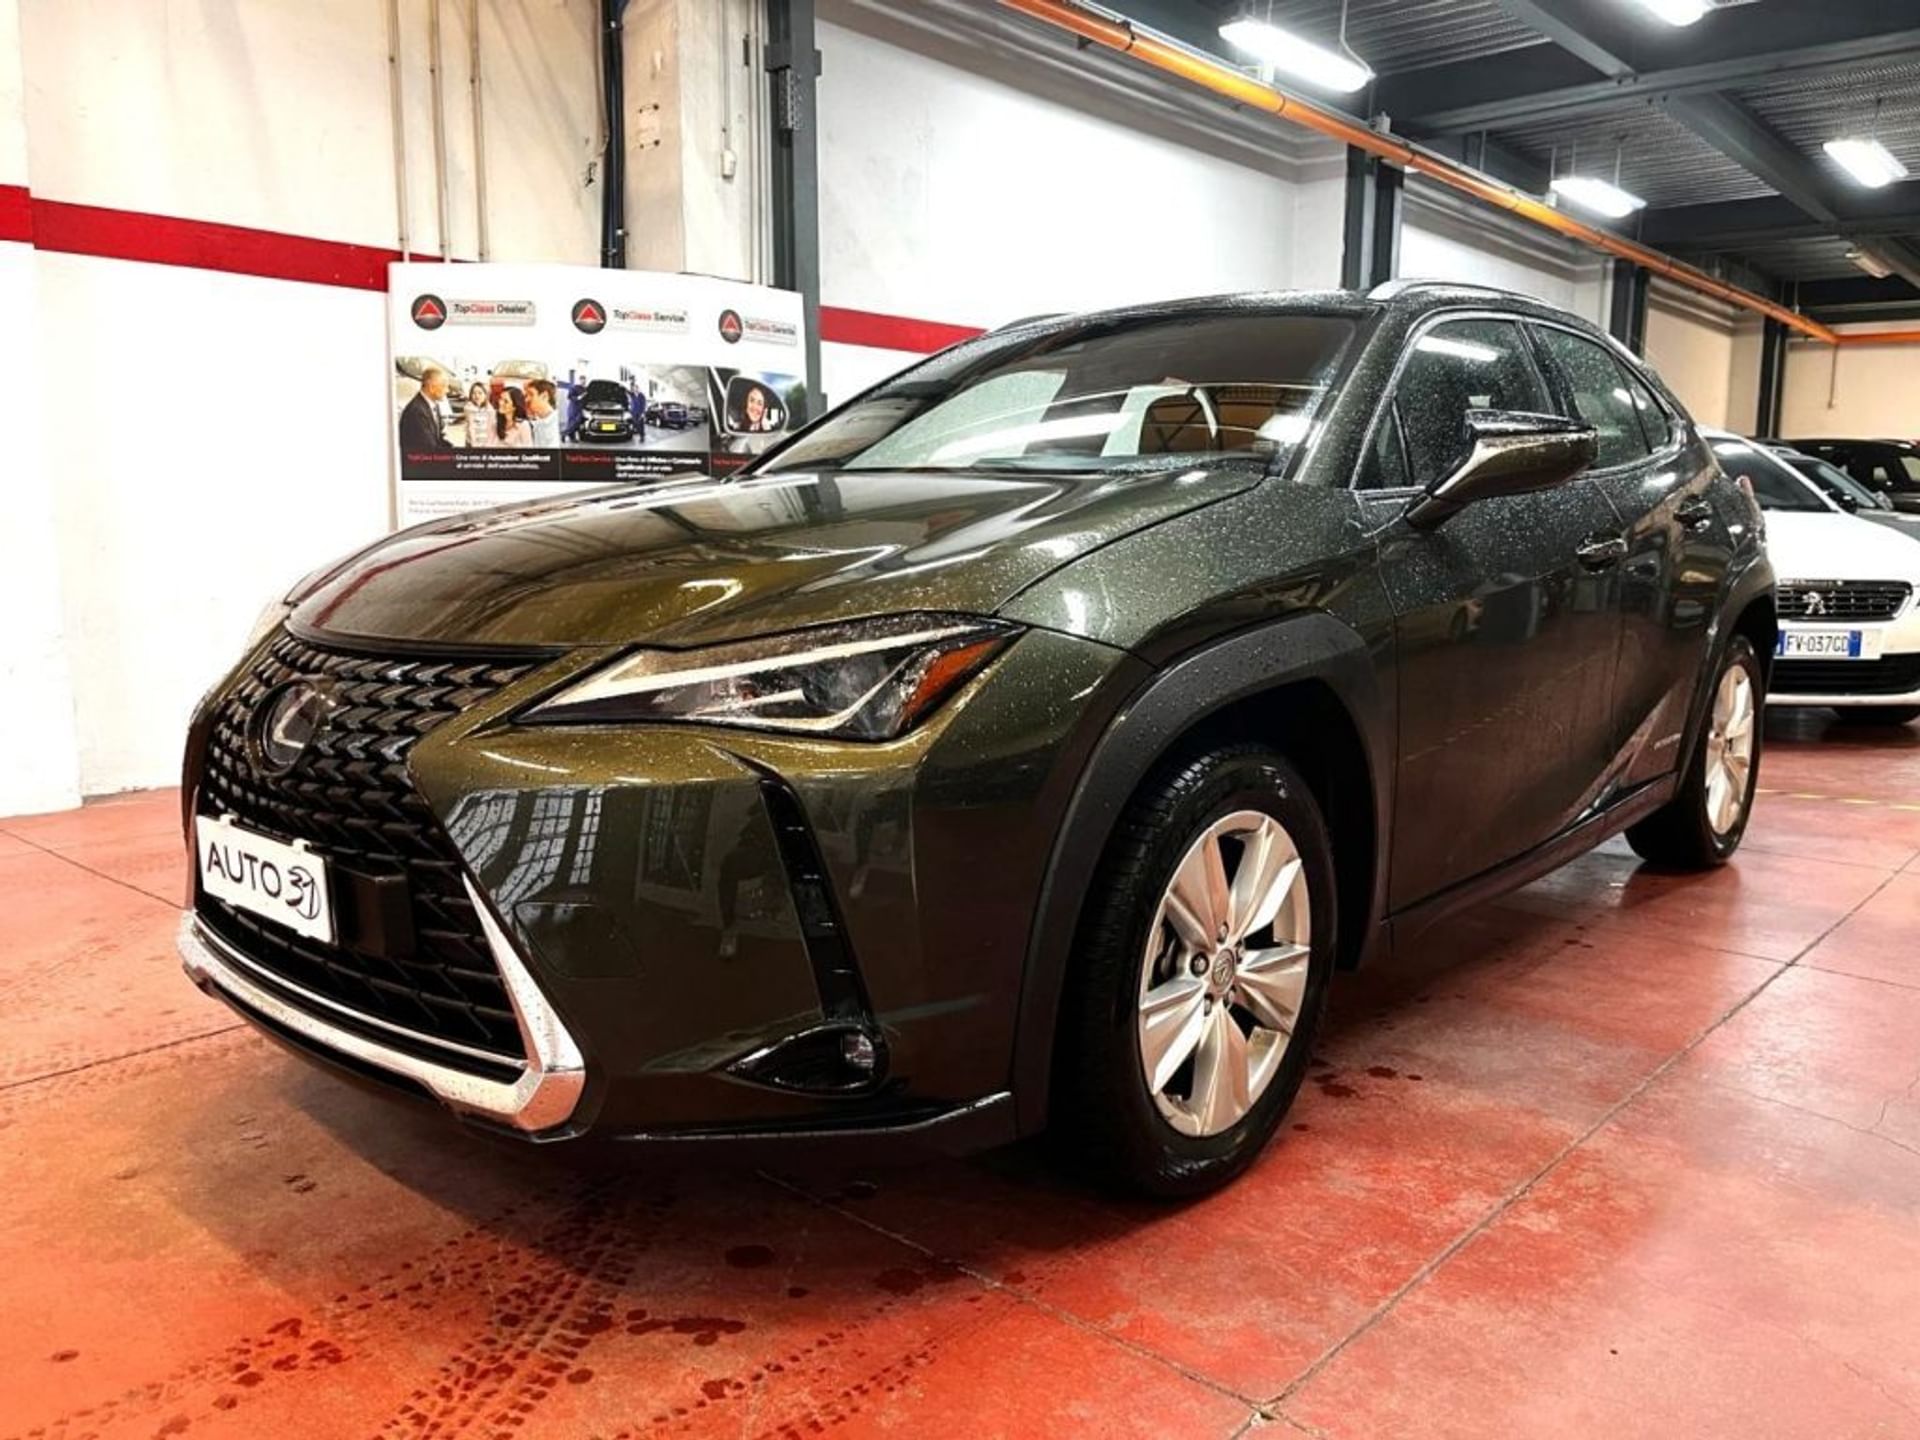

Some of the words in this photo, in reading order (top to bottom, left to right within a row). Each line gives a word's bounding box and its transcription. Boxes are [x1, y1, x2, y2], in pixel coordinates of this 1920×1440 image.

[454, 303, 494, 314] TopClass
[497, 303, 527, 313] Dealer
[613, 309, 652, 320] TopClass
[654, 311, 686, 322] Service
[207, 841, 281, 899] AUTO
